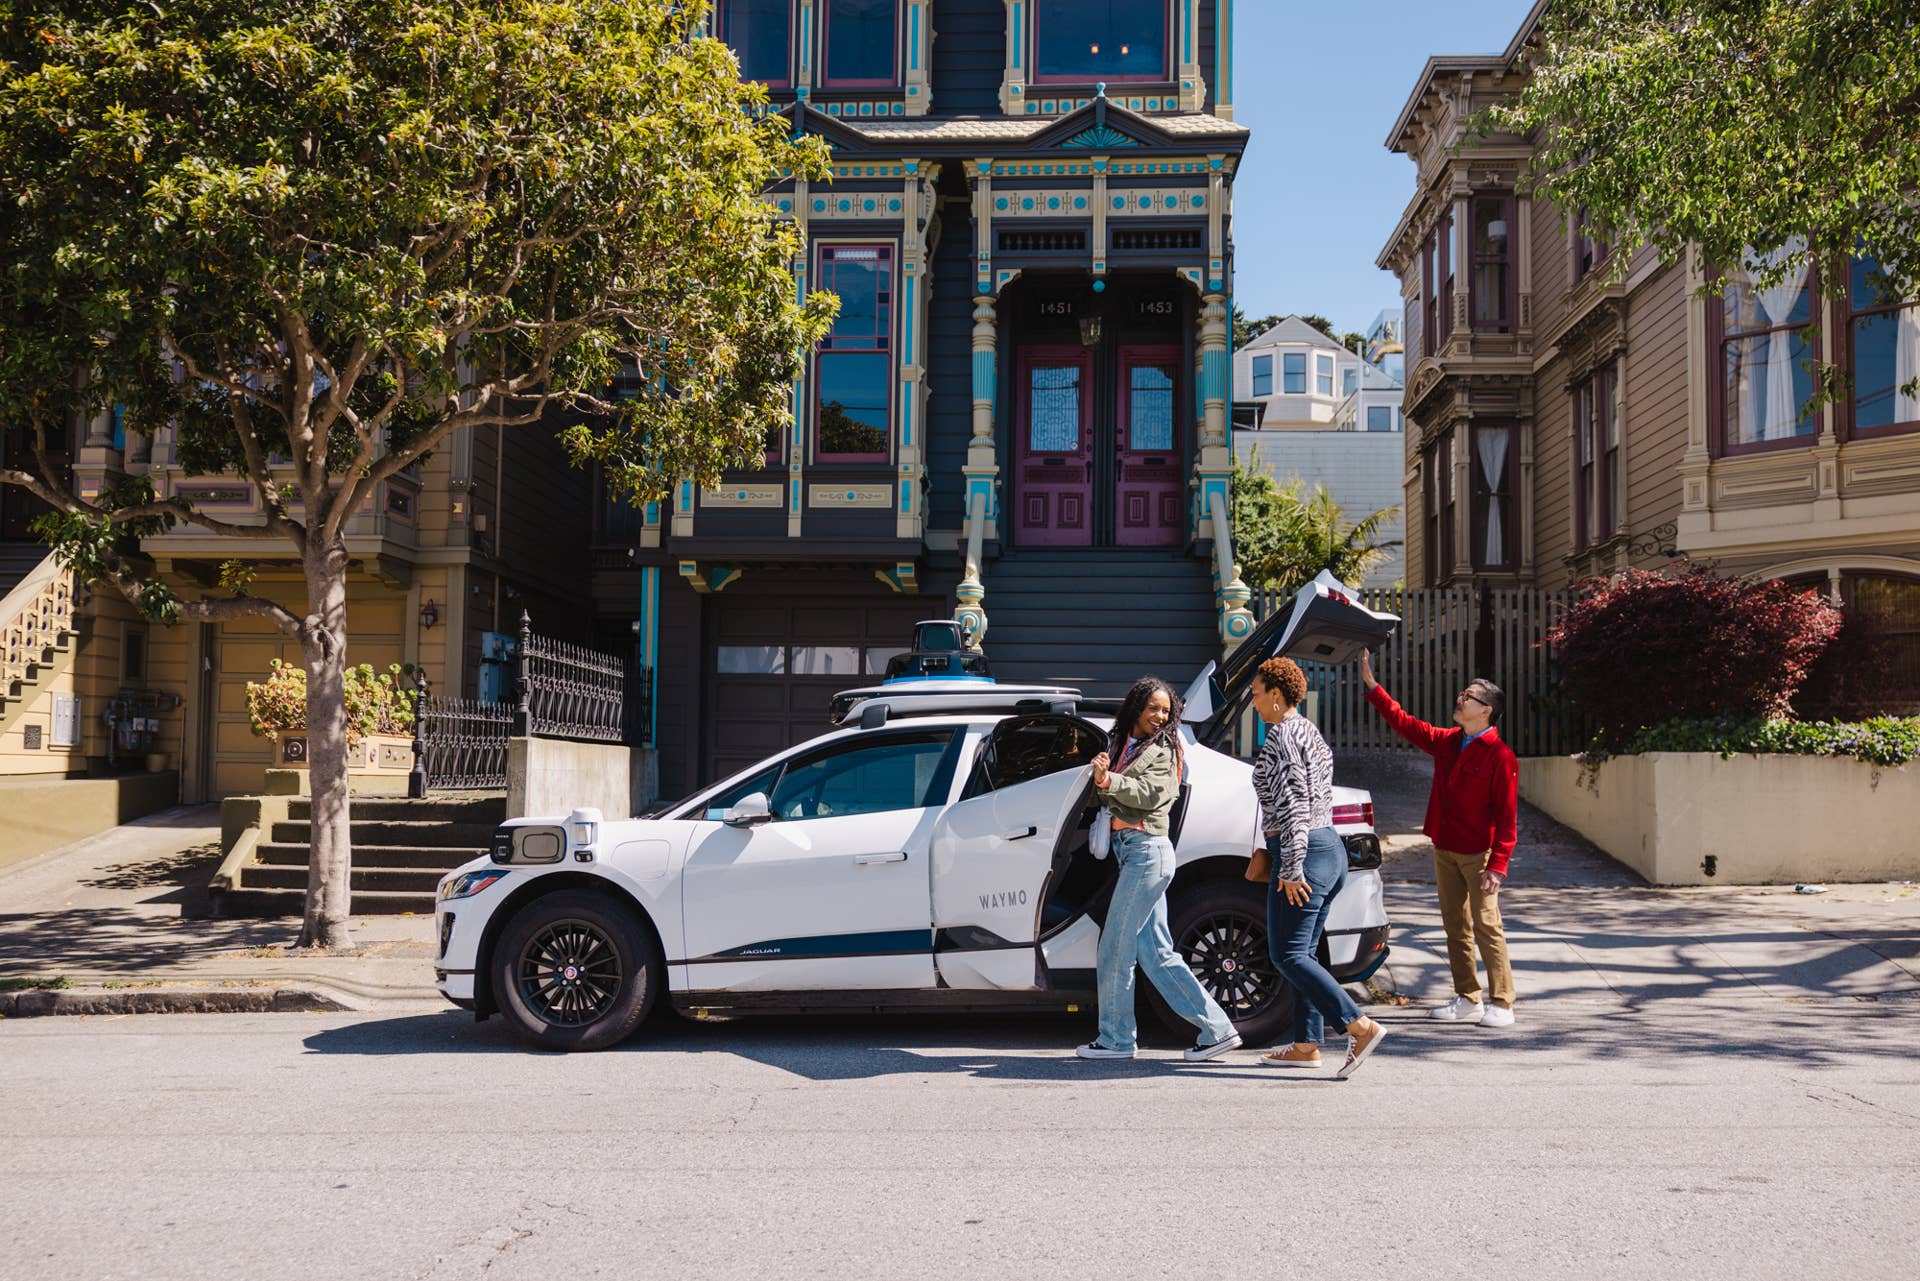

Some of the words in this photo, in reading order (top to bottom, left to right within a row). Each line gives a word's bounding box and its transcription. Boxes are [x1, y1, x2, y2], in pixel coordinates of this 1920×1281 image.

[1041, 302, 1071, 314] 1451
[1140, 302, 1172, 314] 1453
[979, 889, 1026, 910] WAYMO
